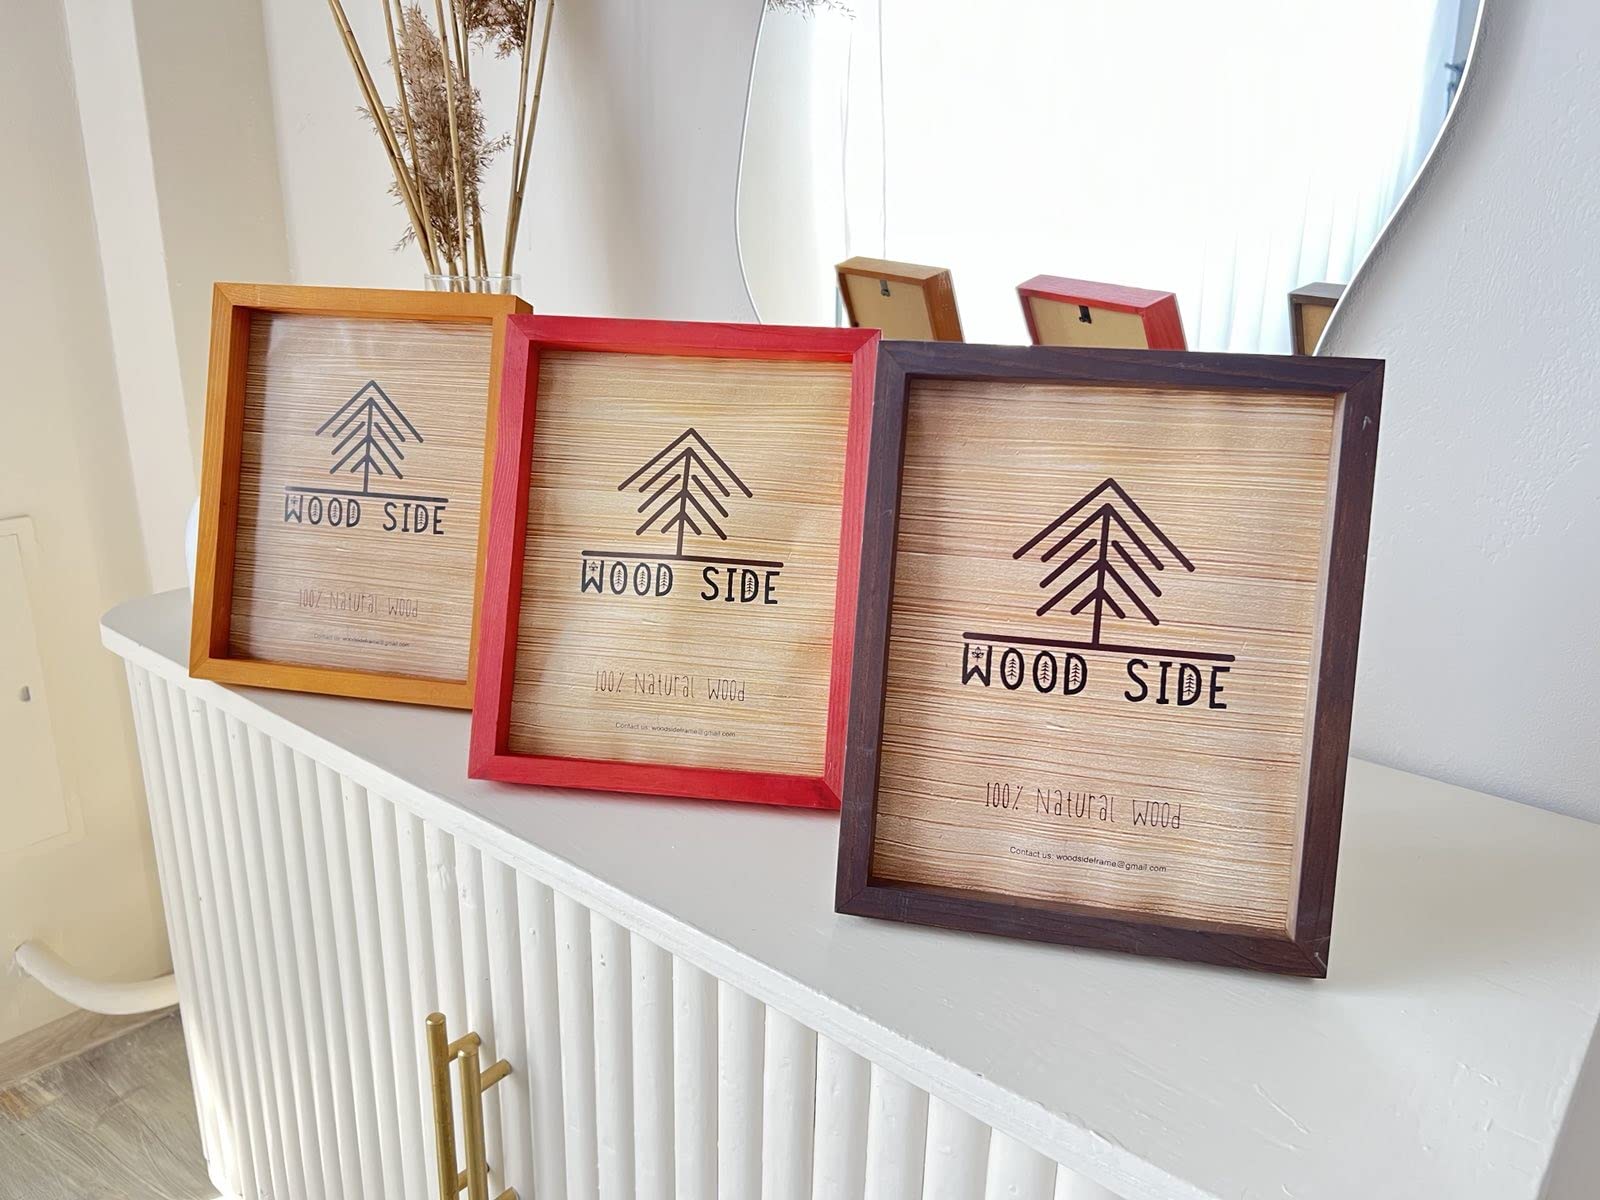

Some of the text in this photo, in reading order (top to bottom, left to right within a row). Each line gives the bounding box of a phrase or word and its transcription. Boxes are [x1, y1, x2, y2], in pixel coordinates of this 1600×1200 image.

[284, 494, 446, 535] WOOD SIDE
[581, 559, 780, 605] WOOD SIDE
[299, 588, 322, 609] 100%
[330, 591, 378, 614] Natural
[594, 670, 625, 693] 100%
[634, 672, 696, 699] Natural
[962, 643, 1231, 709] WOOD SIDE
[615, 721, 640, 731] Contact
[984, 782, 1023, 811] 100%
[1035, 787, 1115, 823] Natural
[1009, 845, 1168, 873] Contact us: woodsideframe@gmail.com
